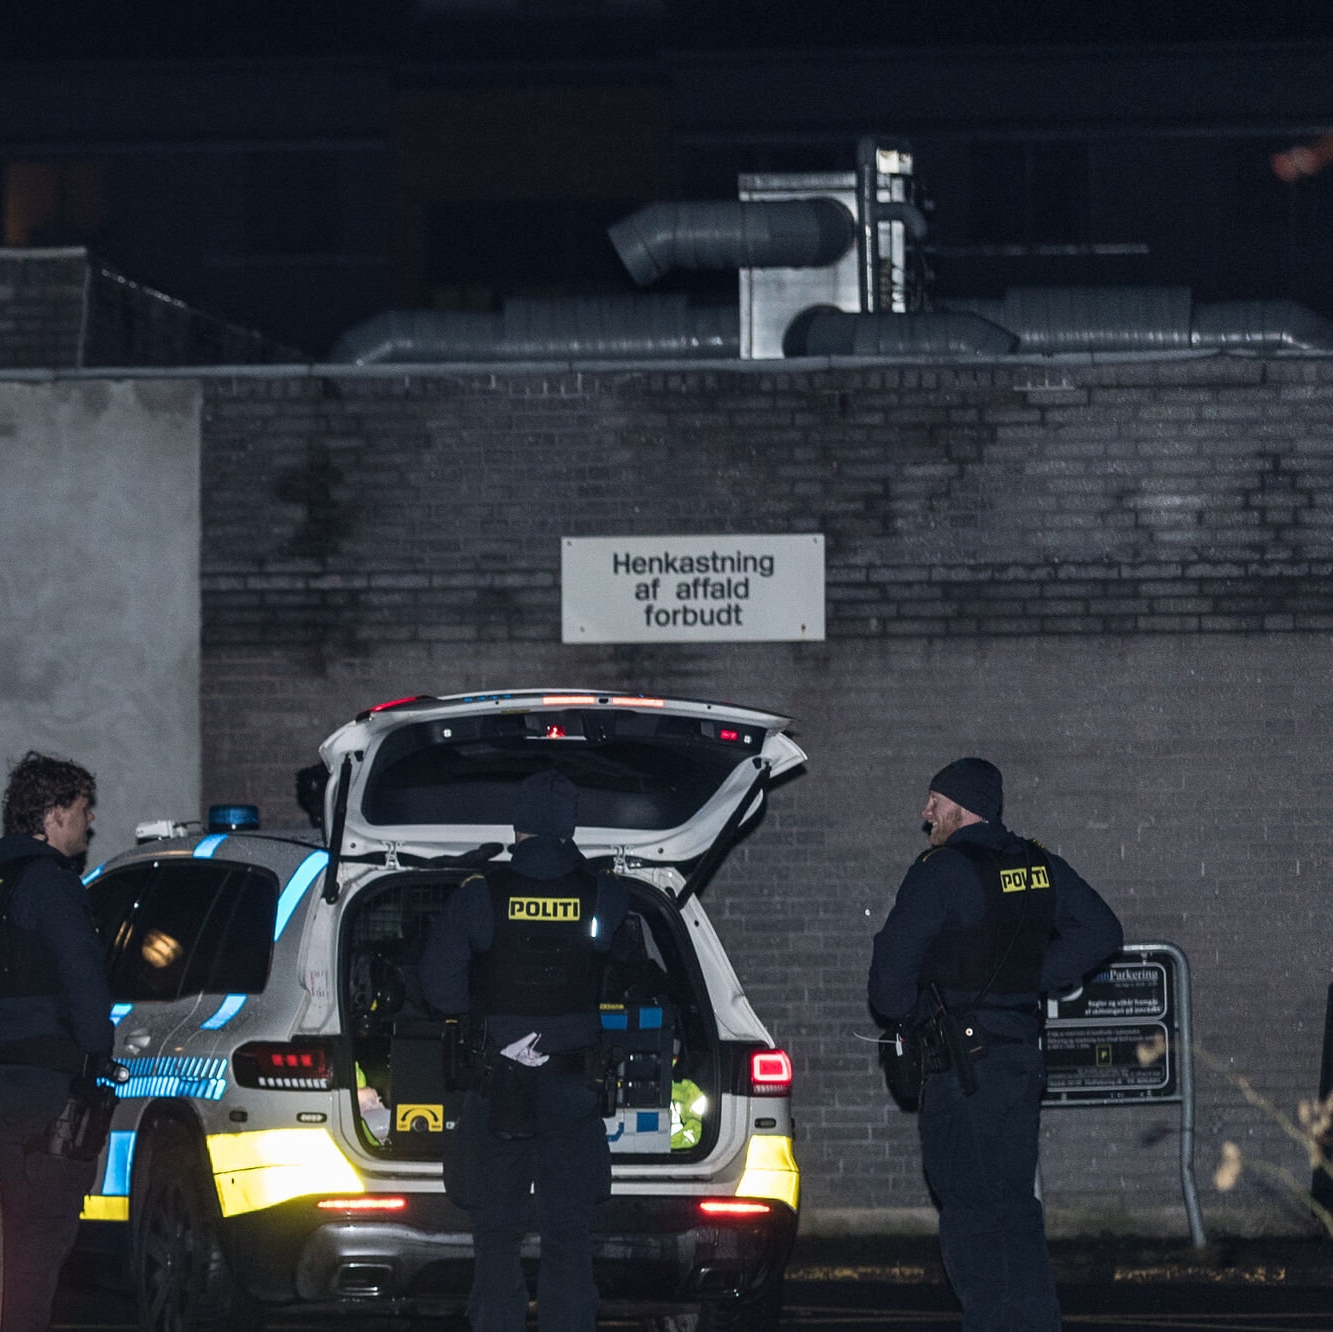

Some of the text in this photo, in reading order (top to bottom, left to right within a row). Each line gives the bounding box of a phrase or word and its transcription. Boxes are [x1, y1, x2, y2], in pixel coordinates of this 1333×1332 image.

[612, 551, 775, 578] Henkastning
[634, 577, 750, 601] af affald
[643, 604, 744, 627] forbudt
[510, 900, 578, 918] POLITI
